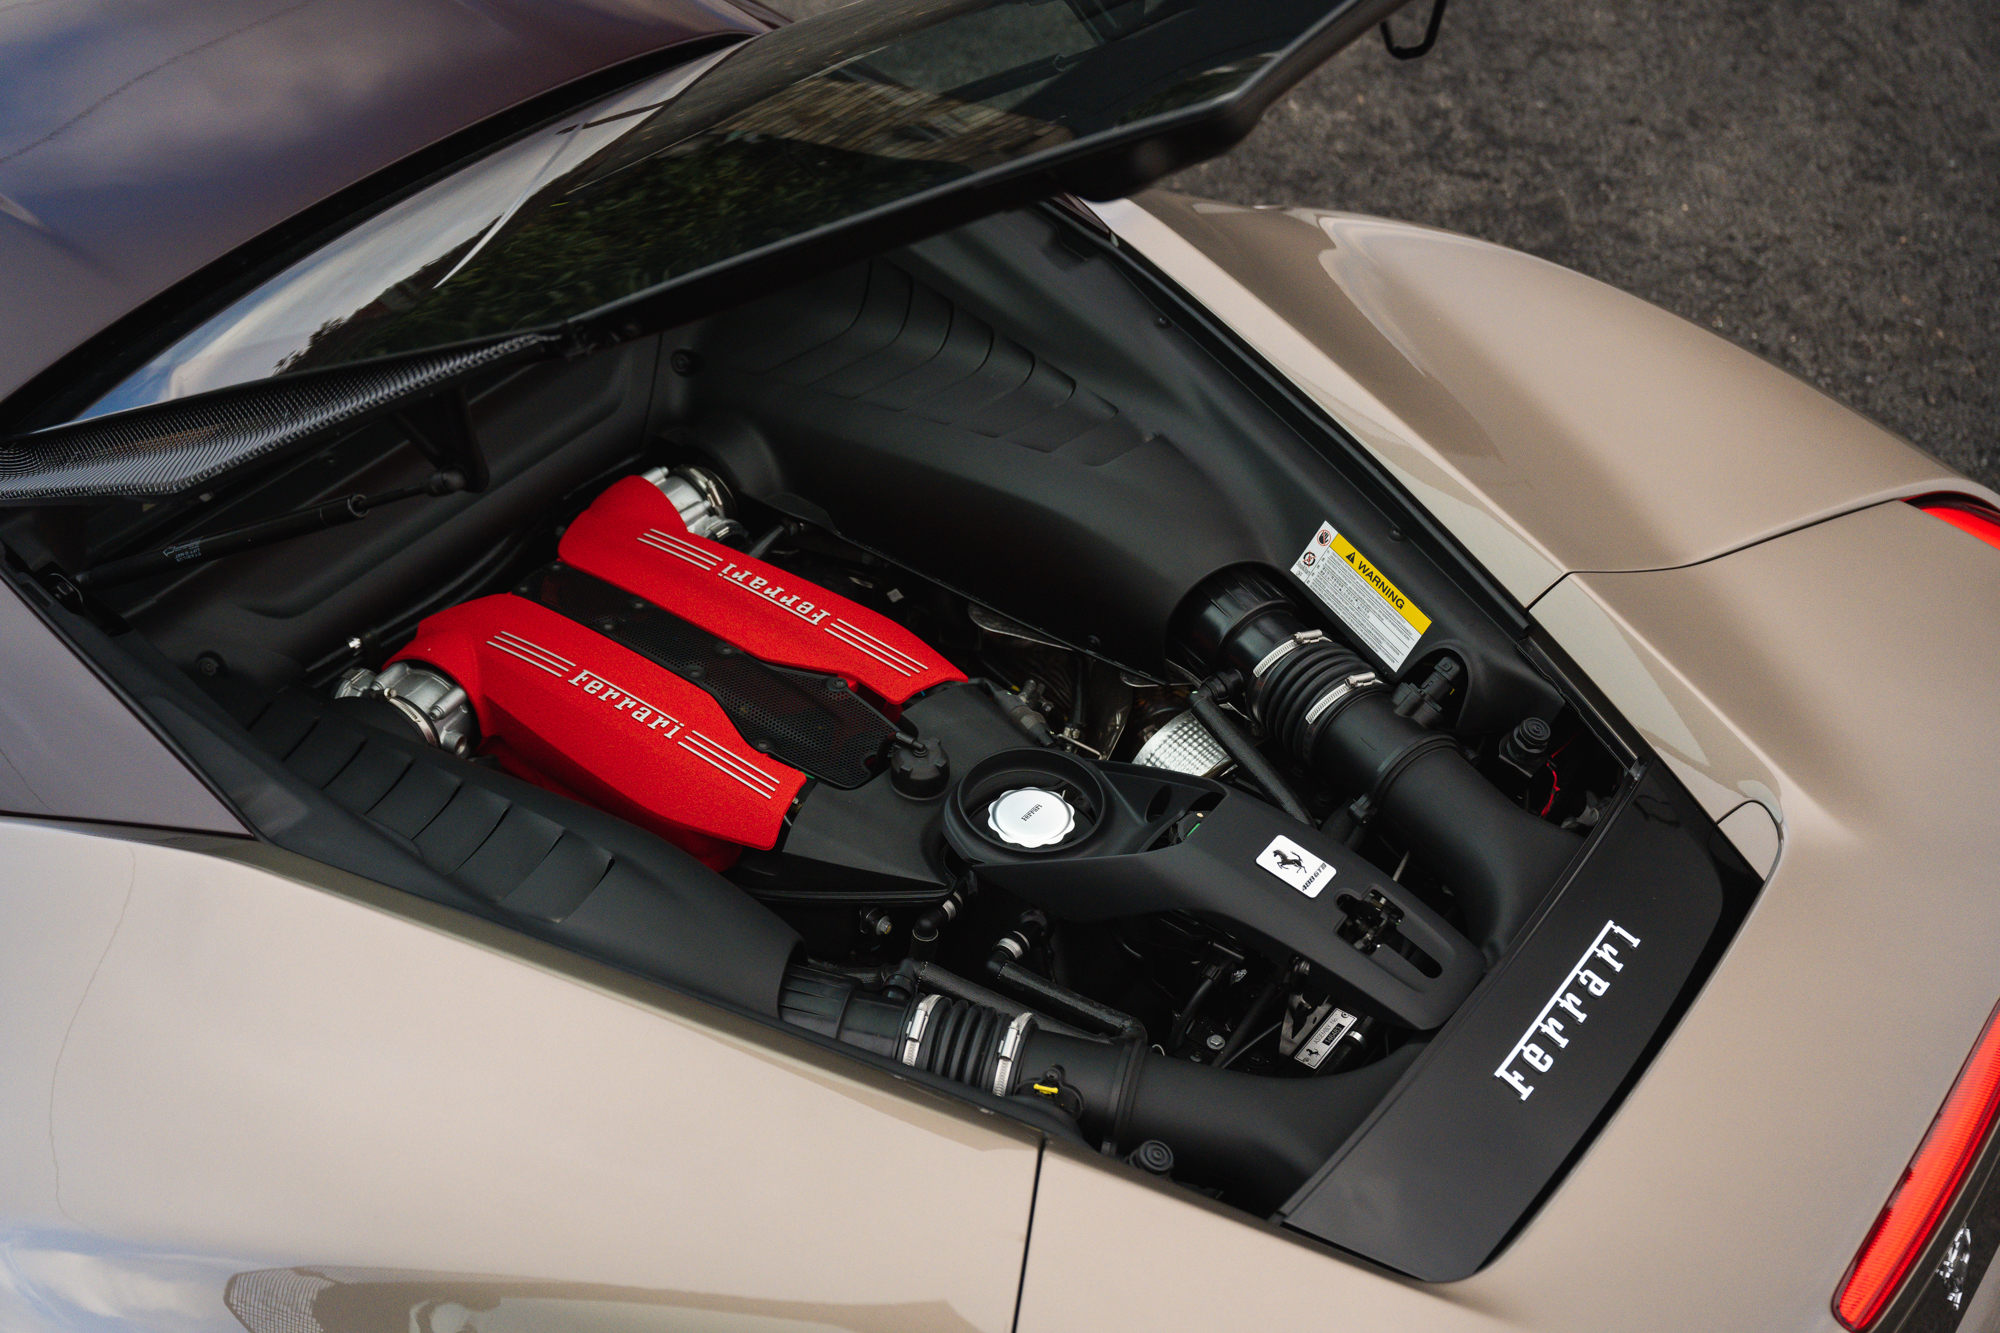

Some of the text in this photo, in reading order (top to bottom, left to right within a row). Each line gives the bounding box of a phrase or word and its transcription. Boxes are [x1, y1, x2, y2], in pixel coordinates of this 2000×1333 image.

[717, 562, 831, 626] Ferrari
[1357, 560, 1405, 610] WARNING
[568, 669, 685, 740] Ferrari
[1021, 804, 1042, 821] Ferrari
[1302, 876, 1315, 891] 488
[1493, 919, 1641, 1101] Ferrari
